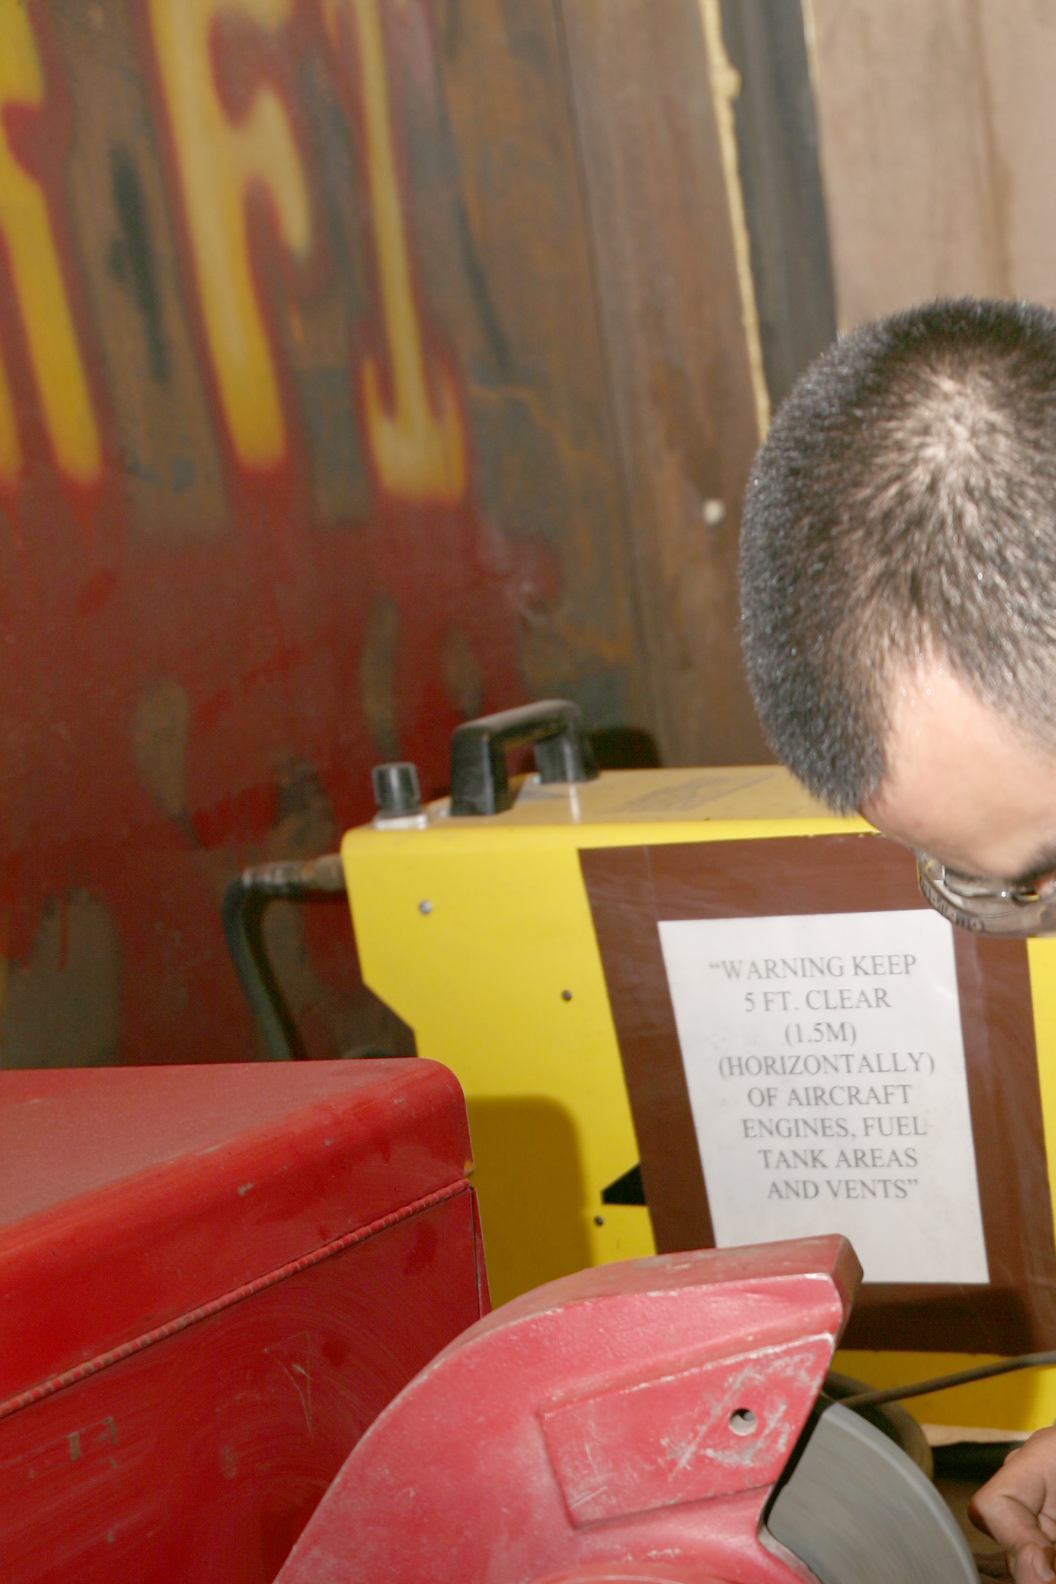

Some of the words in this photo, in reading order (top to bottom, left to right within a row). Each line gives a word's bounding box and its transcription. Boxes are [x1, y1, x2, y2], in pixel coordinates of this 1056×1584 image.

[708, 956, 845, 981] “WARNING
[851, 953, 917, 976] KEEP
[744, 991, 755, 1012] 5
[762, 991, 799, 1011] FT.
[805, 987, 892, 1010] CLEAR
[784, 1021, 857, 1047] (1.5M)
[718, 1051, 935, 1081] (HORIZONTALLY)
[747, 1086, 778, 1107] OF
[787, 1084, 912, 1107] AIRCRAFT
[742, 1117, 857, 1141] ENGINES,
[862, 1115, 927, 1137] FUEL
[758, 1148, 828, 1169] TANK
[836, 1147, 918, 1168] AREAS
[767, 1179, 820, 1199] AND
[825, 1177, 919, 1199] VENTS”
